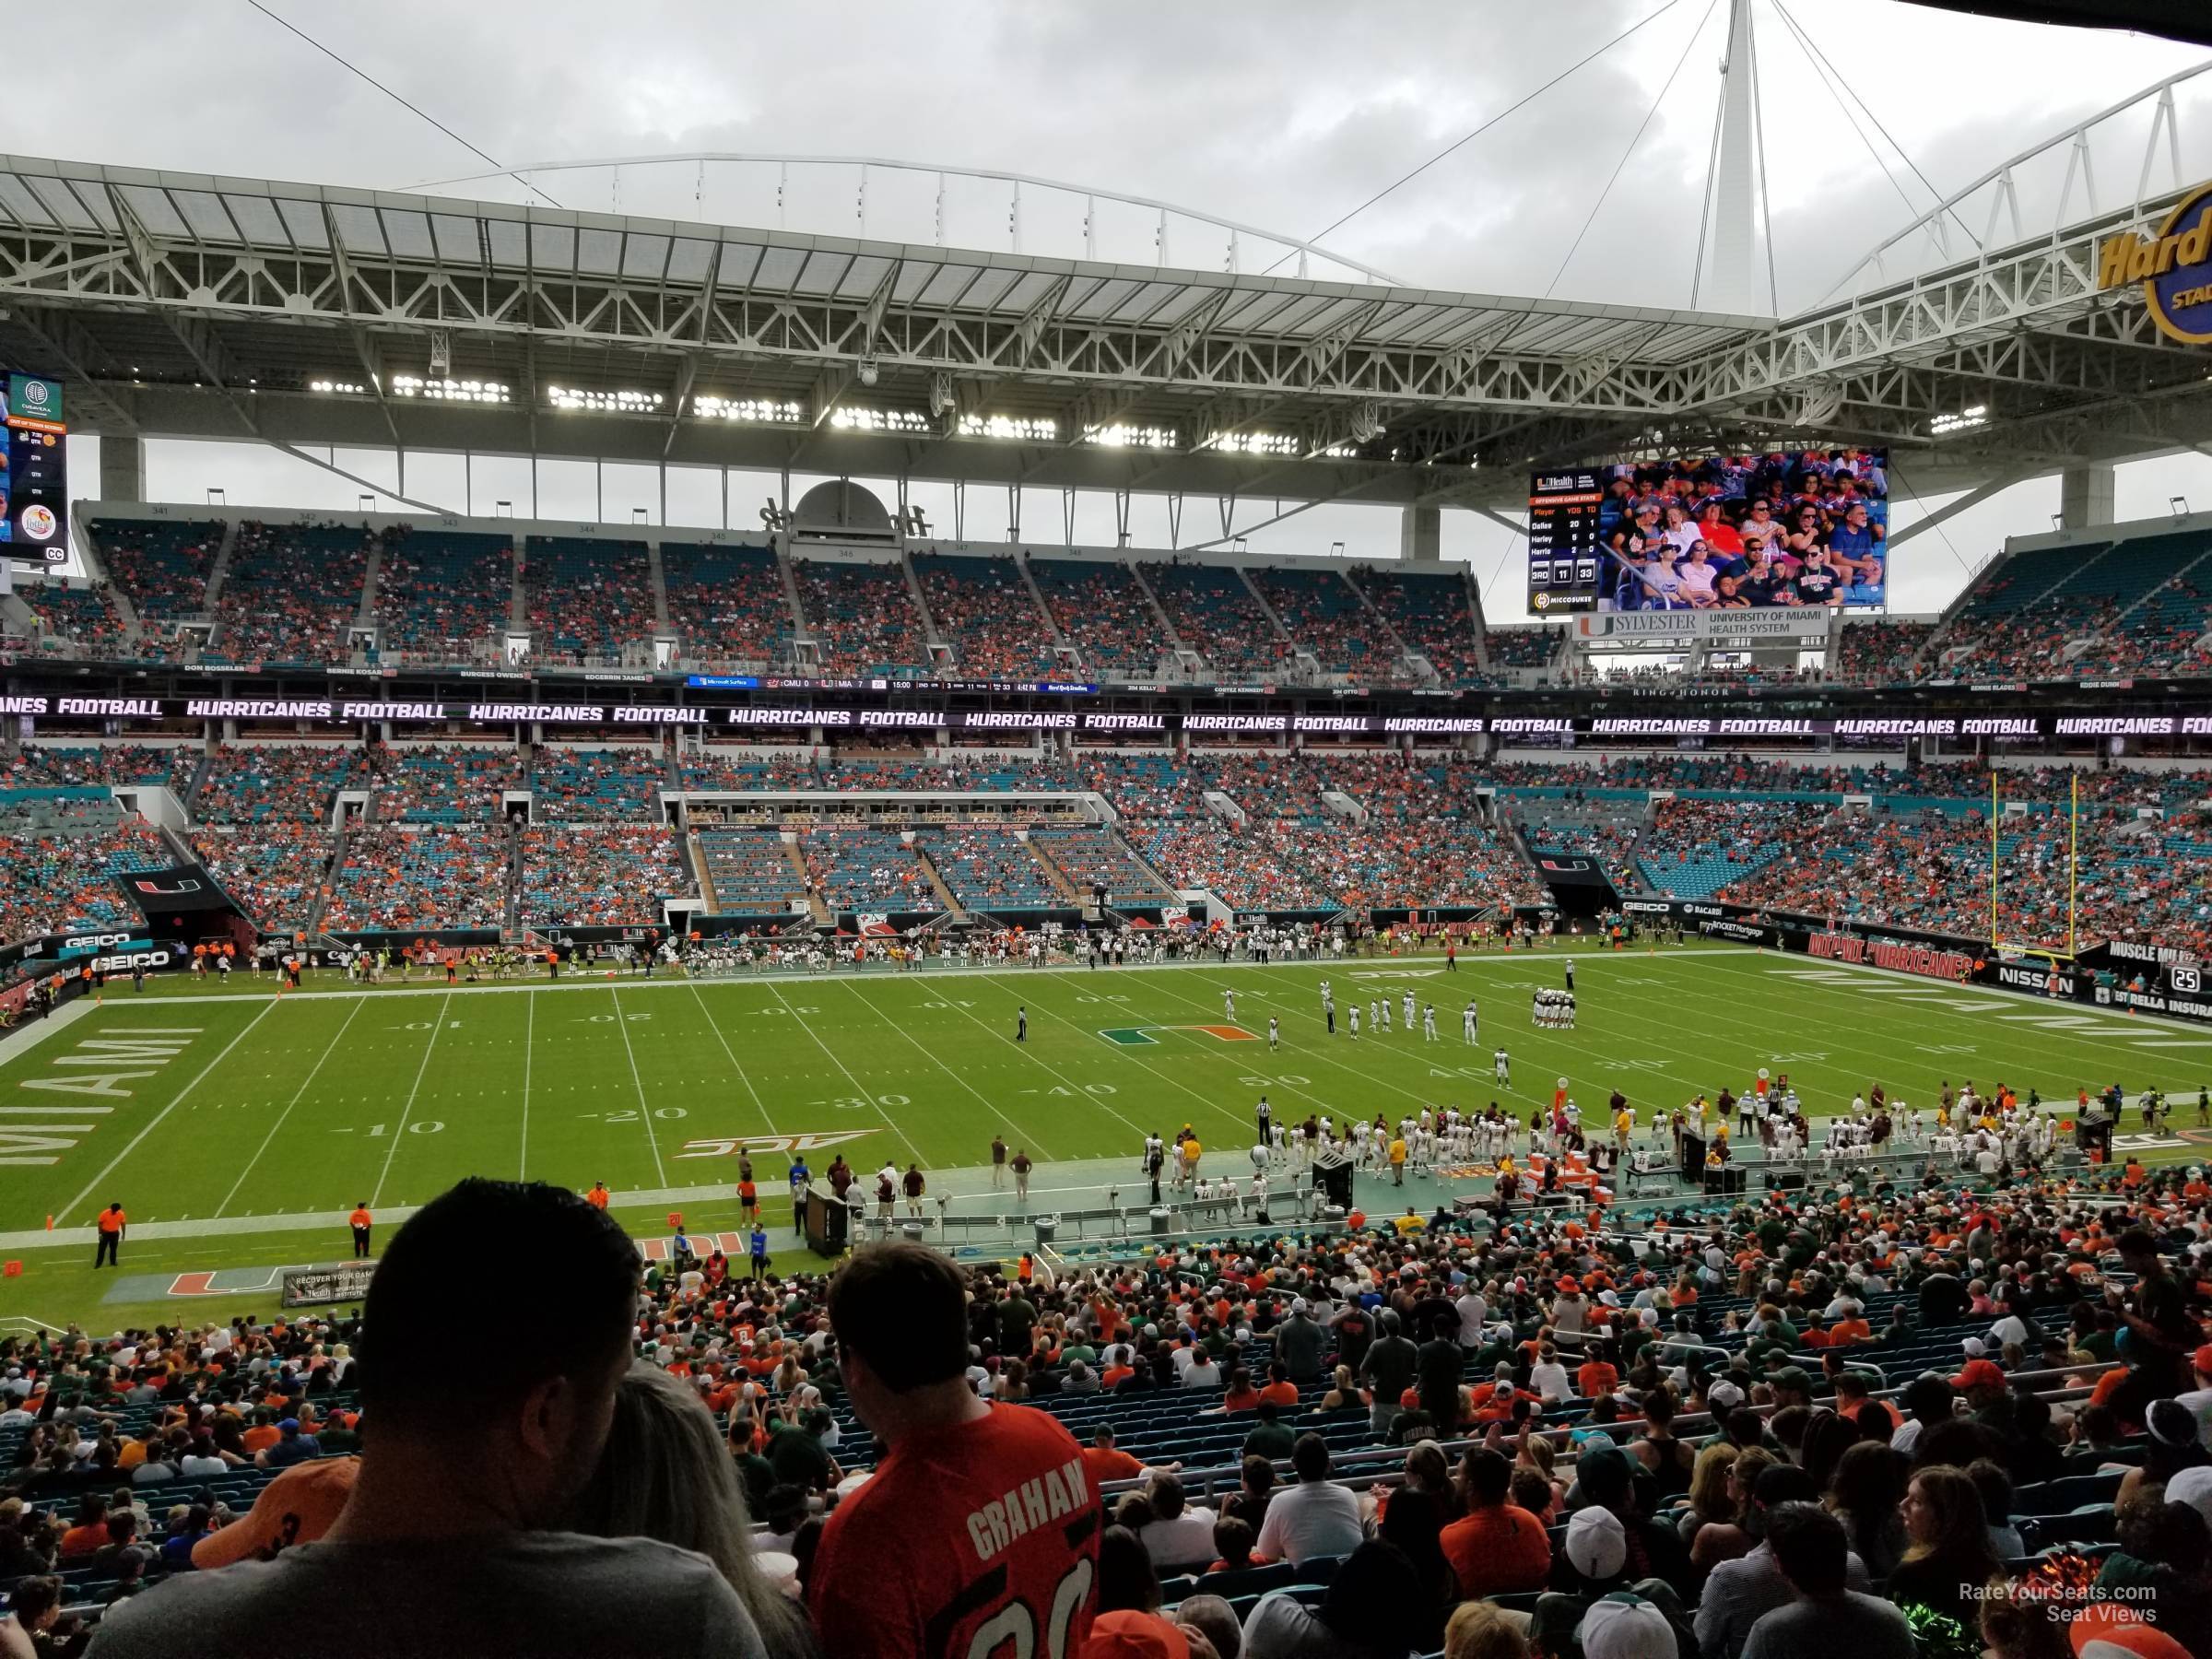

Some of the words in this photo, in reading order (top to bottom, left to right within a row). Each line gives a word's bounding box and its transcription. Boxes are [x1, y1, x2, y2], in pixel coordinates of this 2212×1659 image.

[2097, 206, 2212, 290] Hard
[152, 507, 168, 515] 341
[300, 512, 316, 521] 342
[441, 518, 458, 526] 343
[1570, 520, 1580, 528] 20
[711, 532, 726, 540] 345
[1531, 535, 1552, 544] Harley
[1589, 532, 1594, 540] 0
[48, 549, 63, 559] CC
[1531, 547, 1551, 556] Harris
[1571, 546, 1577, 554] 2
[1588, 545, 1594, 553] 0
[1532, 571, 1548, 580] 3RD
[1559, 570, 1567, 579] 11
[1580, 569, 1593, 578] 33
[1550, 595, 1592, 604] MICCOSUKEE
[1616, 614, 1697, 630] SYLVESTER
[1709, 611, 1770, 623] UNIVERSITY
[1771, 611, 1785, 621] OF
[1786, 610, 1821, 621] MIAMI
[1709, 624, 1748, 634] HEALTH
[1749, 623, 1790, 633] SYSTEM
[1632, 688, 1667, 697] RING
[1679, 688, 1730, 697] HONOR
[58, 699, 163, 715] FOOTBALL
[187, 700, 331, 717] HURRICANES
[342, 702, 448, 719] FOOTBALL
[469, 704, 604, 722] HURRICANES
[614, 707, 709, 723] FOOTBALL
[729, 709, 851, 724] HURRICANES
[860, 711, 947, 726] FOOTBALL
[965, 712, 1077, 727] HURRICANES
[1085, 714, 1165, 728] FOOTBALL
[1182, 715, 1287, 730] HURRICANES
[1293, 717, 1370, 731] FOOTBALL
[1384, 718, 1484, 732] HURRICANES
[1490, 719, 1574, 733] FOOTBALL
[1592, 719, 1711, 733] HURRICANES
[1720, 719, 1814, 733] FOOTBALL
[1834, 720, 1956, 734] HURRICANES
[1961, 719, 2039, 734] FOOTBALL
[2055, 717, 2172, 735] HURRICANES
[1622, 901, 1670, 912] GEICO
[1239, 913, 1267, 924] UHealth
[1713, 921, 1736, 932] ROCKET
[1736, 924, 1764, 937] Mortgage
[65, 933, 130, 948] GEICO
[1808, 933, 1865, 963] MIAMI
[1867, 942, 1973, 980] HURRICANES
[2110, 940, 2156, 961] MUSCLE
[91, 950, 170, 972] GEICO
[2176, 971, 2195, 989] 25
[2115, 990, 2166, 1010] ESTRELLA
[1238, 1075, 1312, 1088] 50
[1047, 1084, 1118, 1096] 40
[833, 1094, 912, 1109] 30
[605, 1107, 688, 1123] 20
[363, 1121, 445, 1136] 10
[1198, 1263, 1208, 1271] 19
[296, 1275, 331, 1285] RECOVER
[333, 1272, 355, 1281] YOUR
[739, 1330, 748, 1344] 8
[967, 1457, 1089, 1561] GRAHAM
